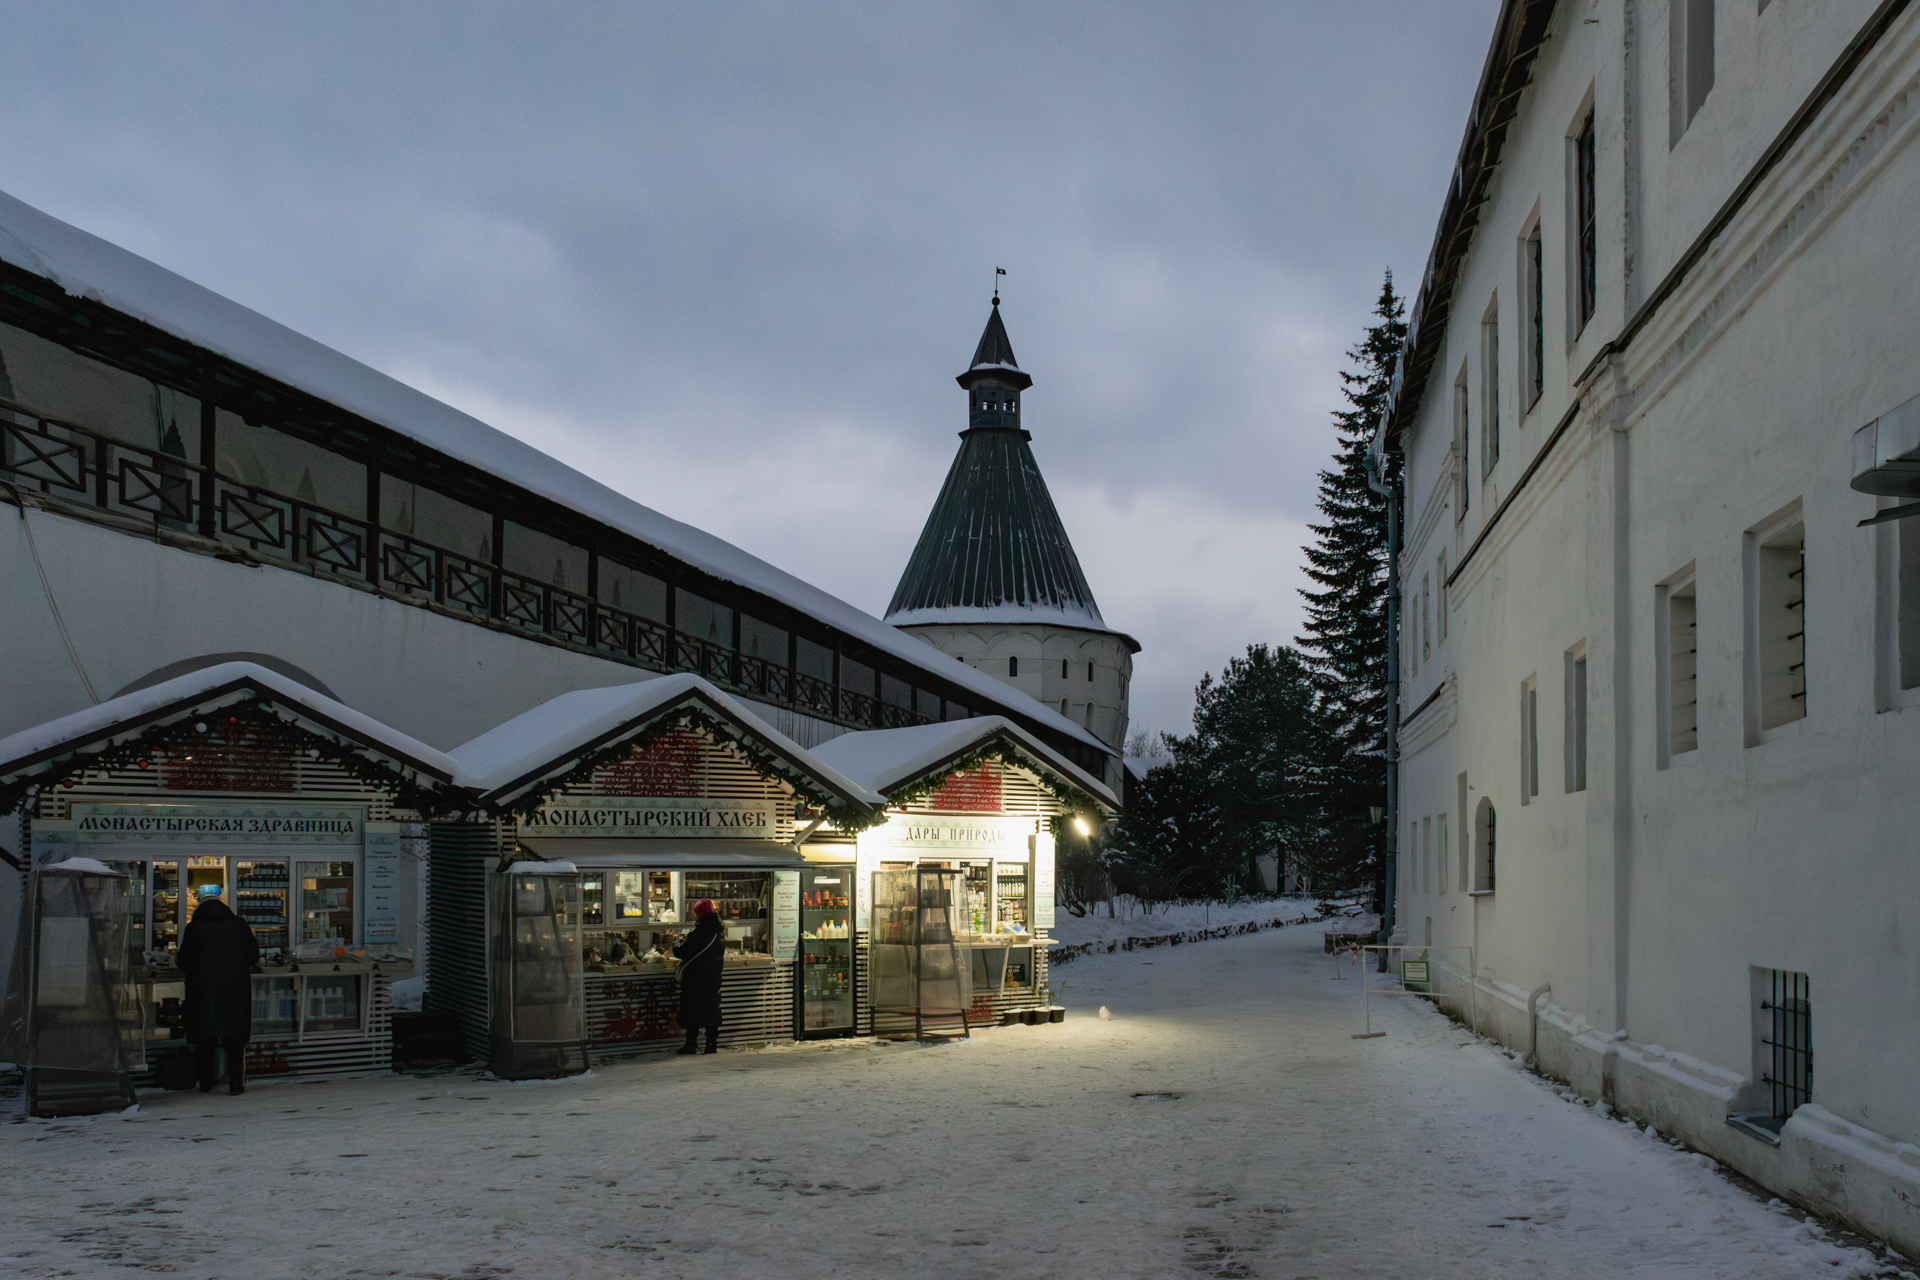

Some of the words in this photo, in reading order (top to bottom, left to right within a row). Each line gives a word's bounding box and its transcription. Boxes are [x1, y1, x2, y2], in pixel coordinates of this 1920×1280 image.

[78, 817, 244, 833] МОНАСТЫРСКАЯ
[248, 818, 355, 836] ЗДРАВНИЦА
[716, 811, 767, 827] ХЛЕБ
[905, 827, 940, 841] ДАРЫ
[949, 828, 1006, 843] ПРИРОДЫ
